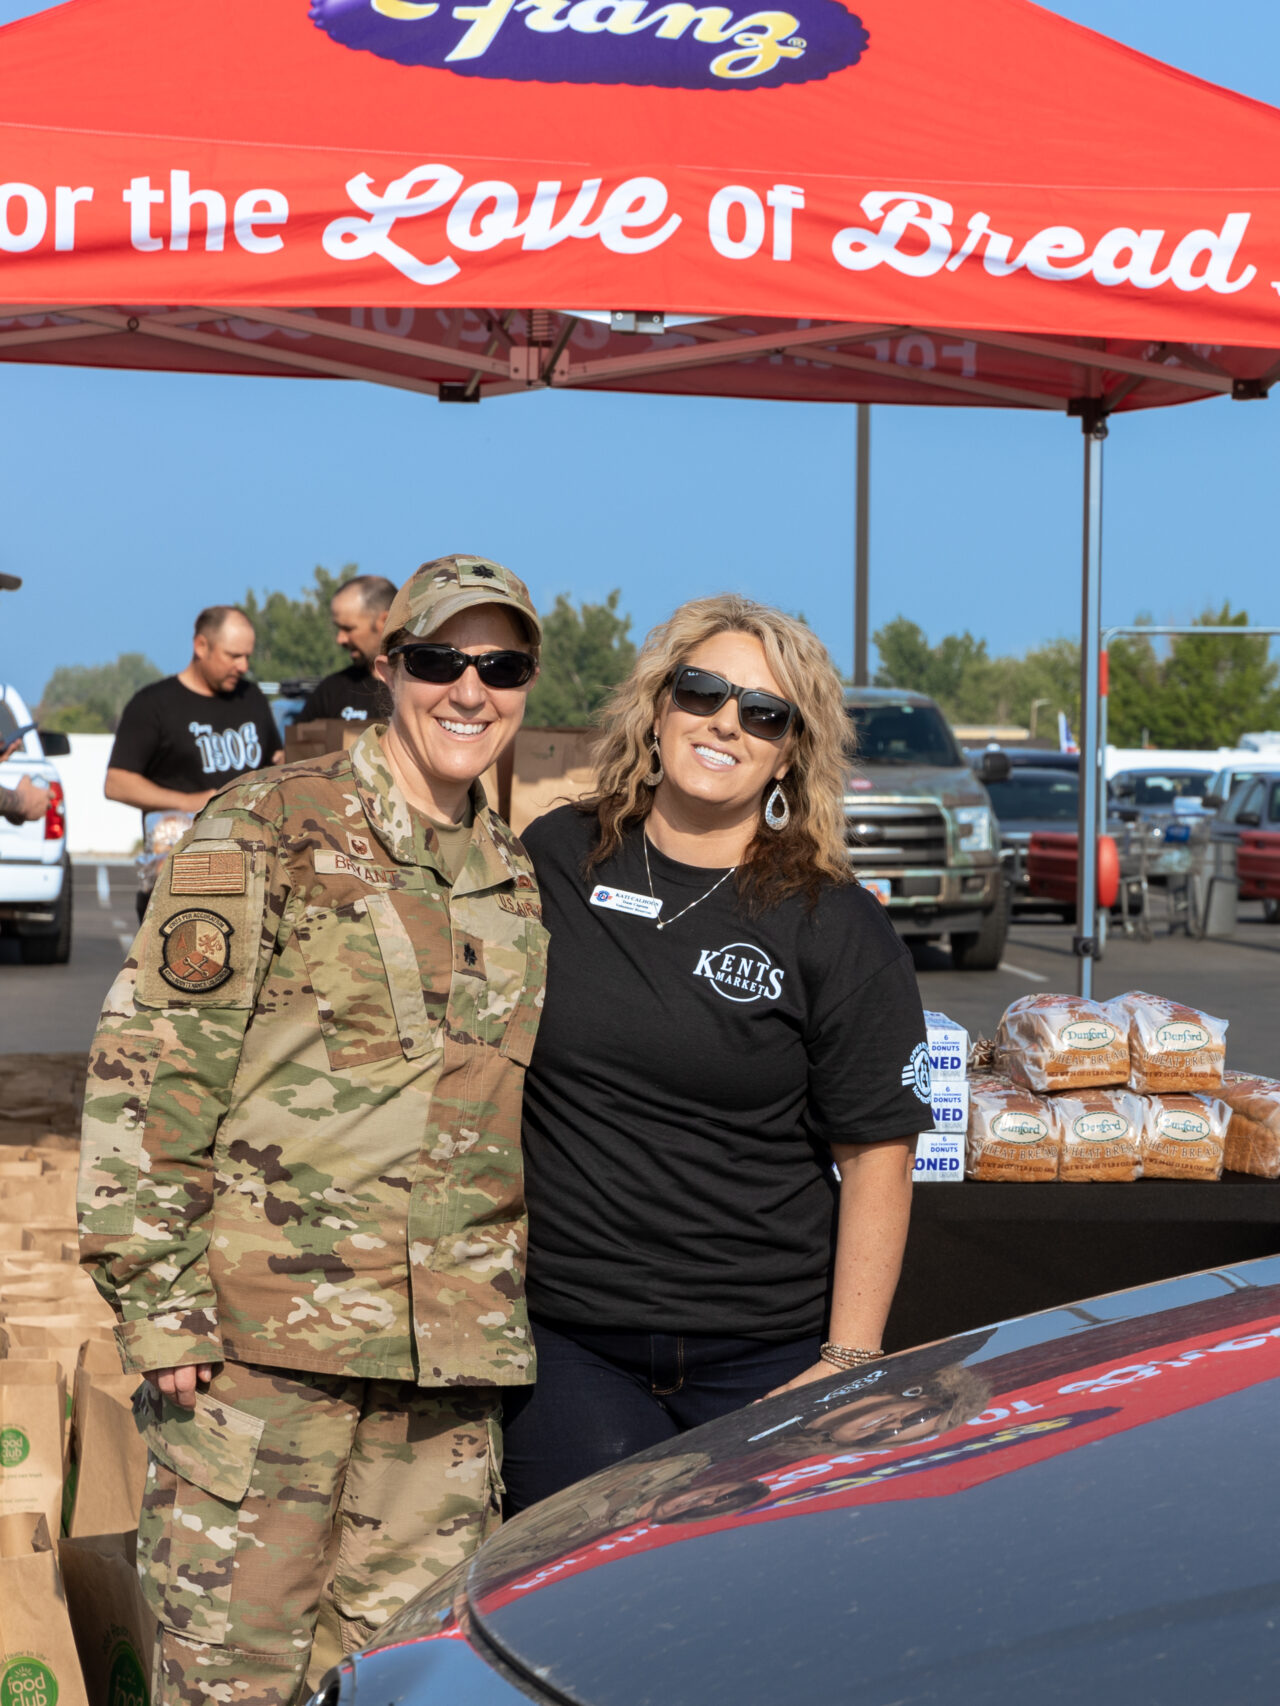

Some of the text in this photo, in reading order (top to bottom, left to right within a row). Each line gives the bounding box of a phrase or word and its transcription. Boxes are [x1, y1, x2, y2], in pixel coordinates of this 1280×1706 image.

[122, 169, 289, 254] the
[321, 162, 683, 286] Love
[708, 184, 805, 261] of
[831, 190, 1257, 294] Bread
[335, 854, 397, 885] BRYANT
[692, 949, 785, 1000] KENTS
[715, 971, 765, 996] MARKET
[1067, 1028, 1109, 1042] Dunford
[1163, 1029, 1203, 1042] Dunford
[1049, 1049, 1129, 1066] WHEAT BREAD
[1143, 1052, 1180, 1067] WHEAT
[1181, 1145, 1220, 1158] BREAD
[7, 1671, 46, 1695] food
[12, 1690, 48, 1706] club
